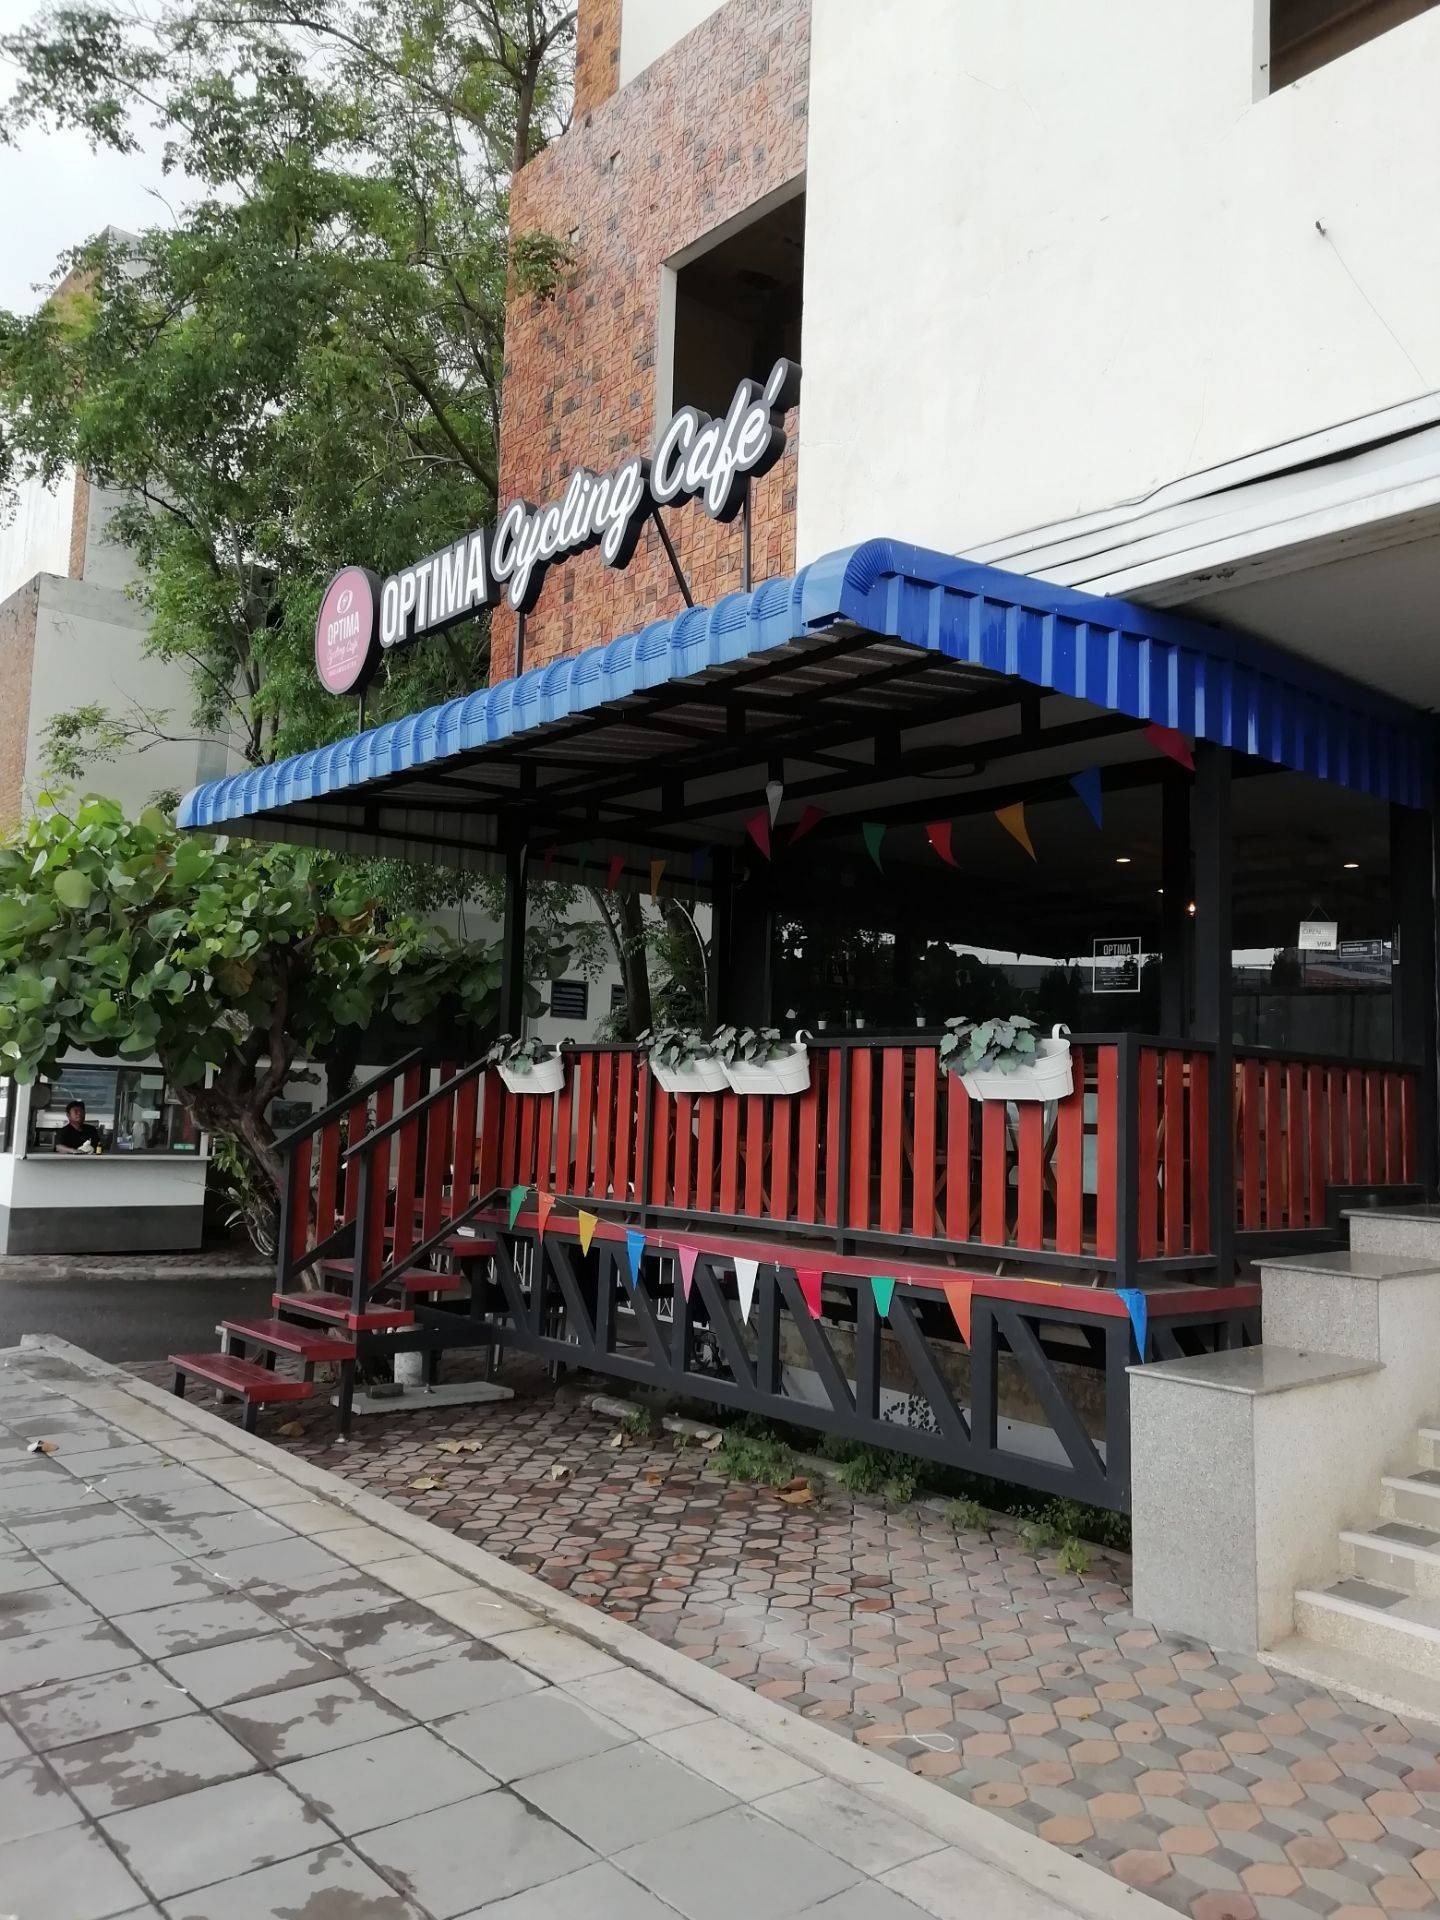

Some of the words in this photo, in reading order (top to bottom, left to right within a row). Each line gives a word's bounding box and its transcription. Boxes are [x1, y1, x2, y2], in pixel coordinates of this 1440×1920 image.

[381, 534, 485, 643] OPTIMA
[495, 462, 643, 604] Cycling
[654, 366, 783, 511] Café
[327, 612, 359, 646] OPTIMA
[1103, 944, 1131, 955] OPTIMA
